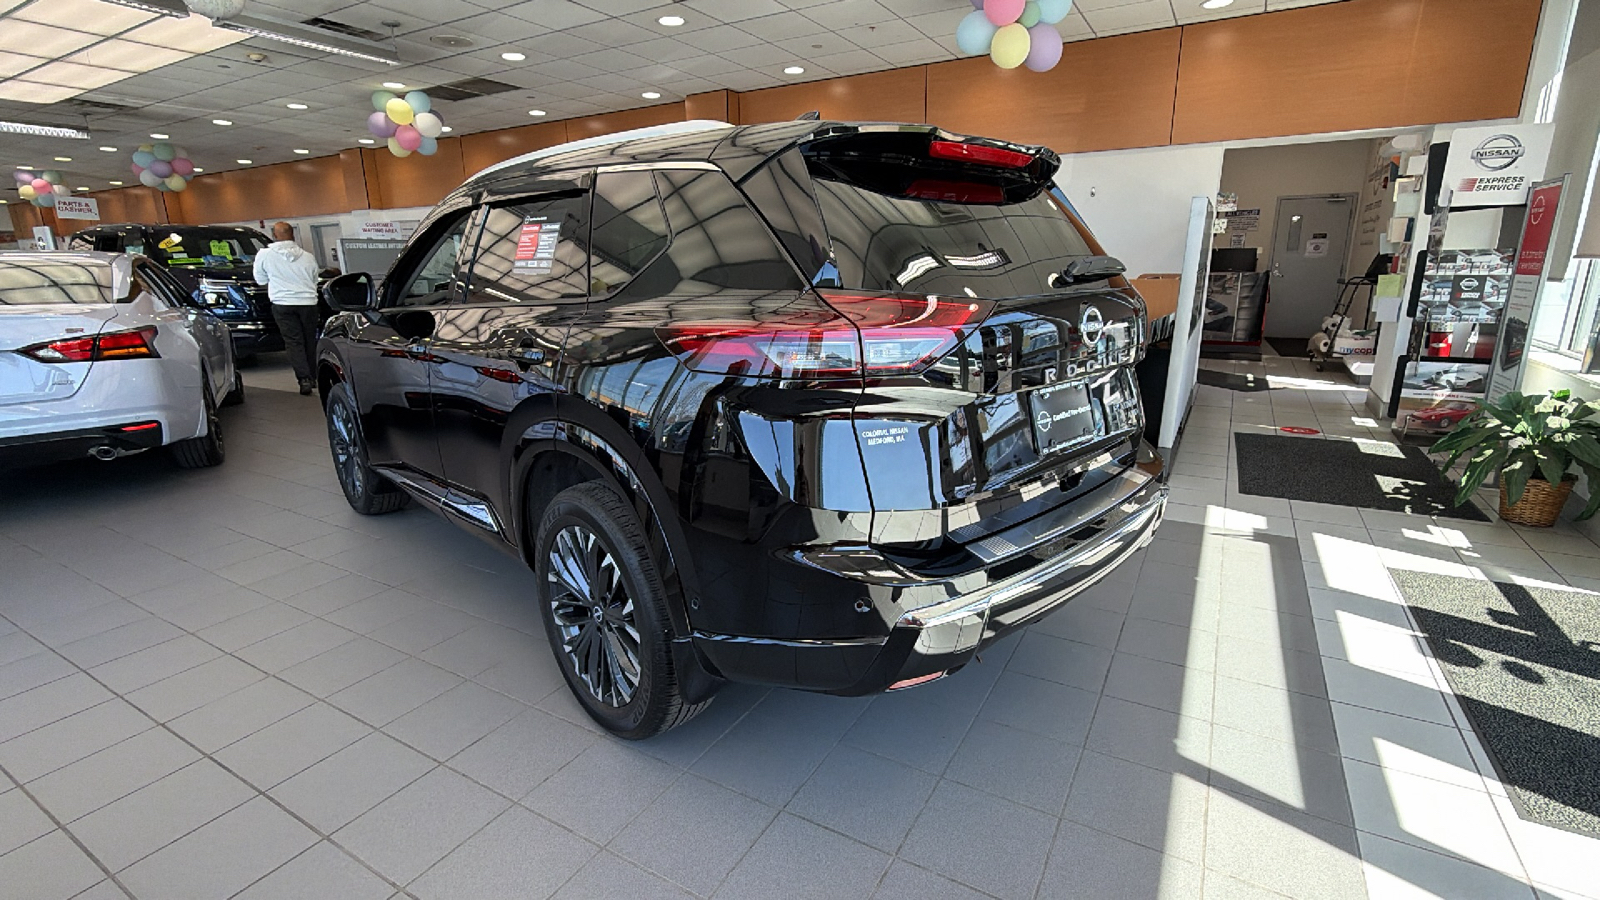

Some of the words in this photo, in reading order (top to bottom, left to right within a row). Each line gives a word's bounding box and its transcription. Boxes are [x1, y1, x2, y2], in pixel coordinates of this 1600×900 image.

[1476, 149, 1520, 158] NISSAN
[1478, 176, 1525, 185] EXPRESS
[1475, 183, 1522, 192] SERVICE
[1045, 349, 1130, 384] ROGUE
[861, 429, 889, 438] COLONIAL
[889, 426, 909, 435] NISSAN
[867, 436, 896, 446] MEDFORD,
